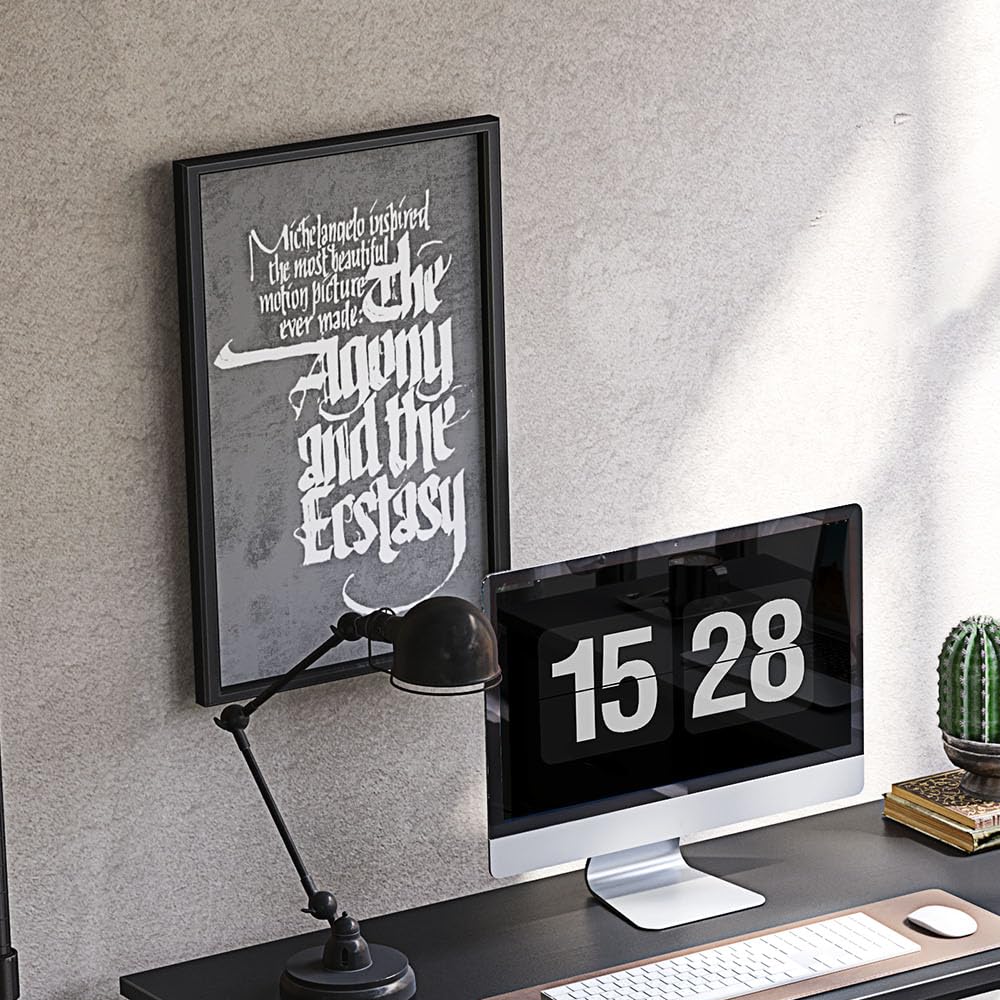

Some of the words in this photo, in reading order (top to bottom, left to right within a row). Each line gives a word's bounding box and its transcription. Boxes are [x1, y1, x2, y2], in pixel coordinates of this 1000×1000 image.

[249, 207, 365, 281] Michelangelo
[369, 189, 431, 240] inspired
[269, 253, 291, 285] the
[294, 246, 329, 277] most
[328, 236, 388, 272] beautiful
[259, 282, 308, 316] motion
[312, 272, 367, 317] picture
[280, 316, 313, 340] ever
[214, 317, 453, 421] Agony
[298, 392, 383, 492] and
[385, 387, 470, 478] the
[293, 468, 467, 615] Ecstasy
[552, 626, 658, 743] 15
[692, 598, 805, 719] 28
